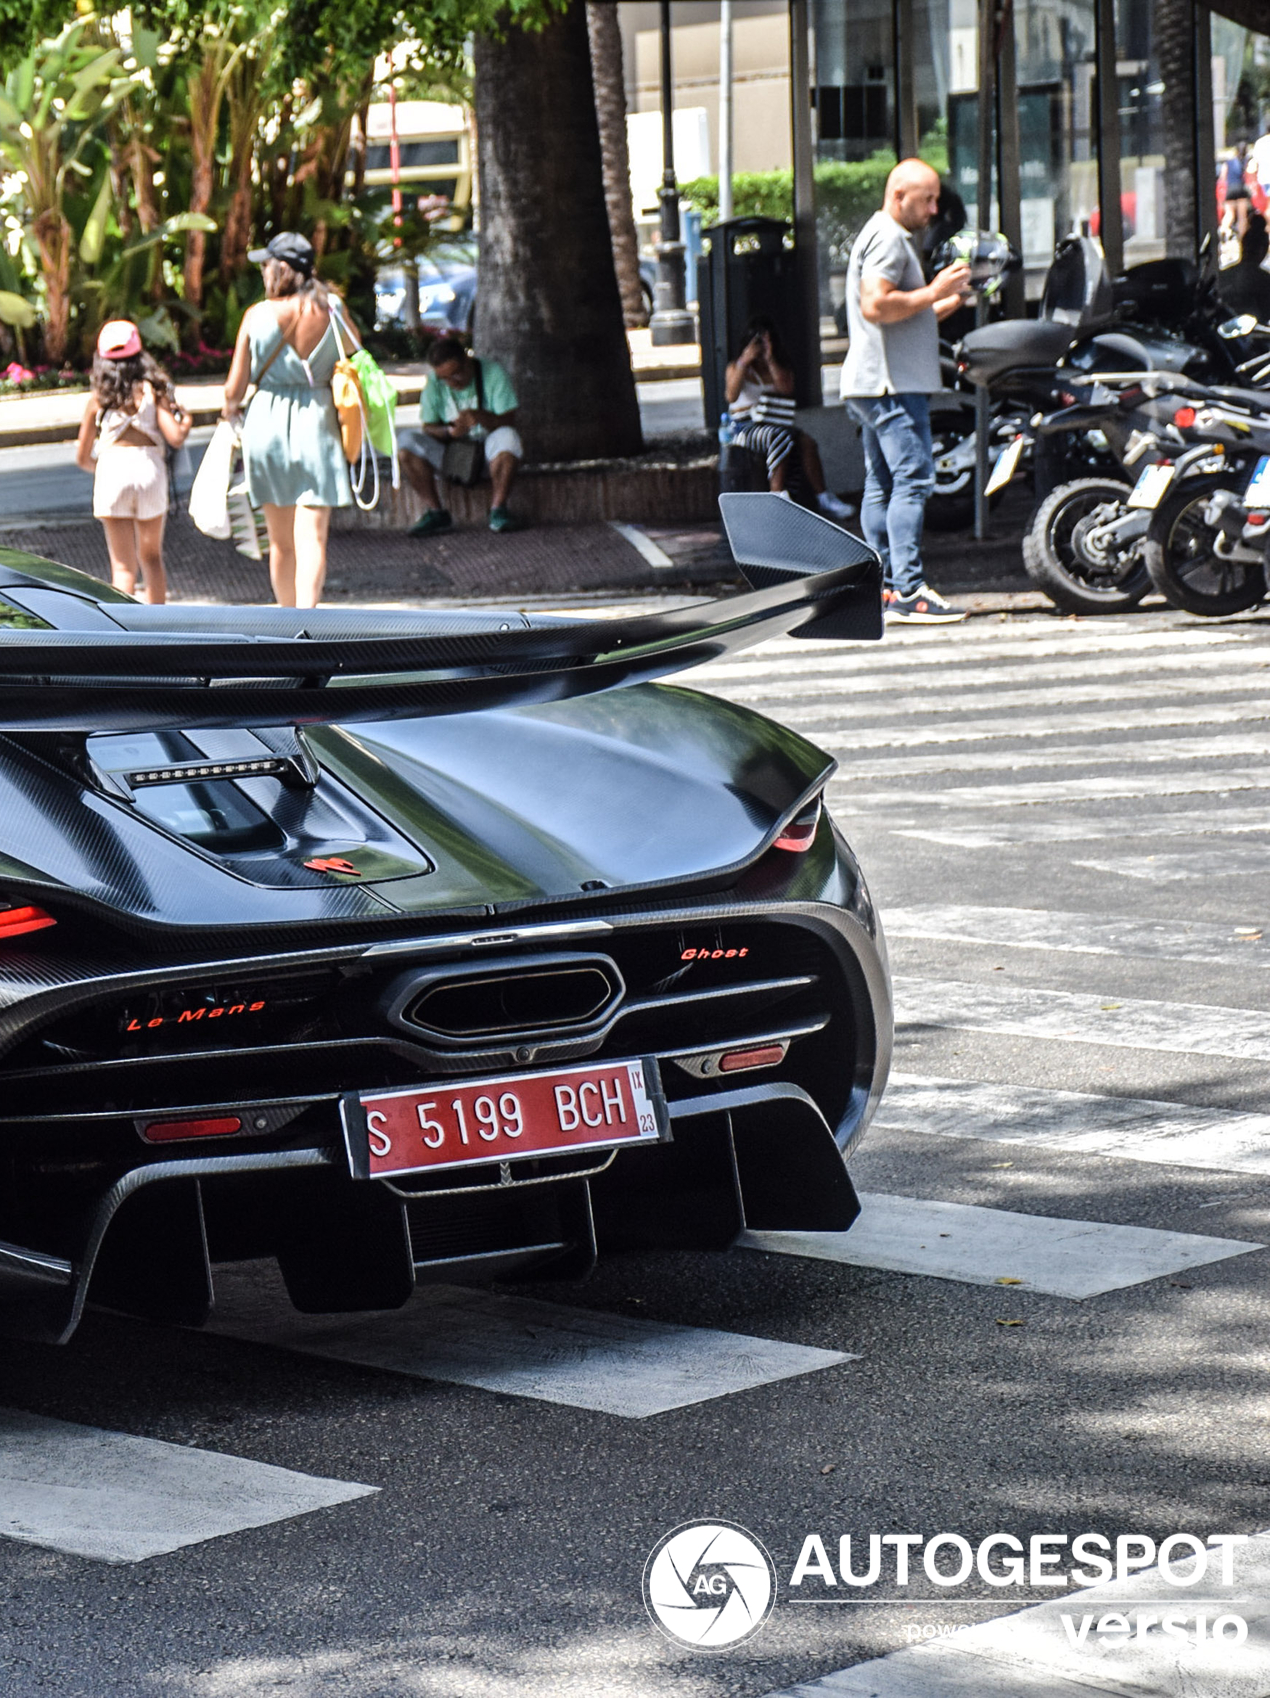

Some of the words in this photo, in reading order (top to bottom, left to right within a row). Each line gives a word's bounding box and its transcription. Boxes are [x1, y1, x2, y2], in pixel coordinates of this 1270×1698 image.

[680, 947, 749, 960] Ghost
[126, 1018, 164, 1031] Le
[177, 1001, 266, 1023] Mans
[367, 1110, 392, 1157] S
[416, 1091, 524, 1149] 5199
[553, 1077, 627, 1132] BCH
[639, 1112, 656, 1133] 23
